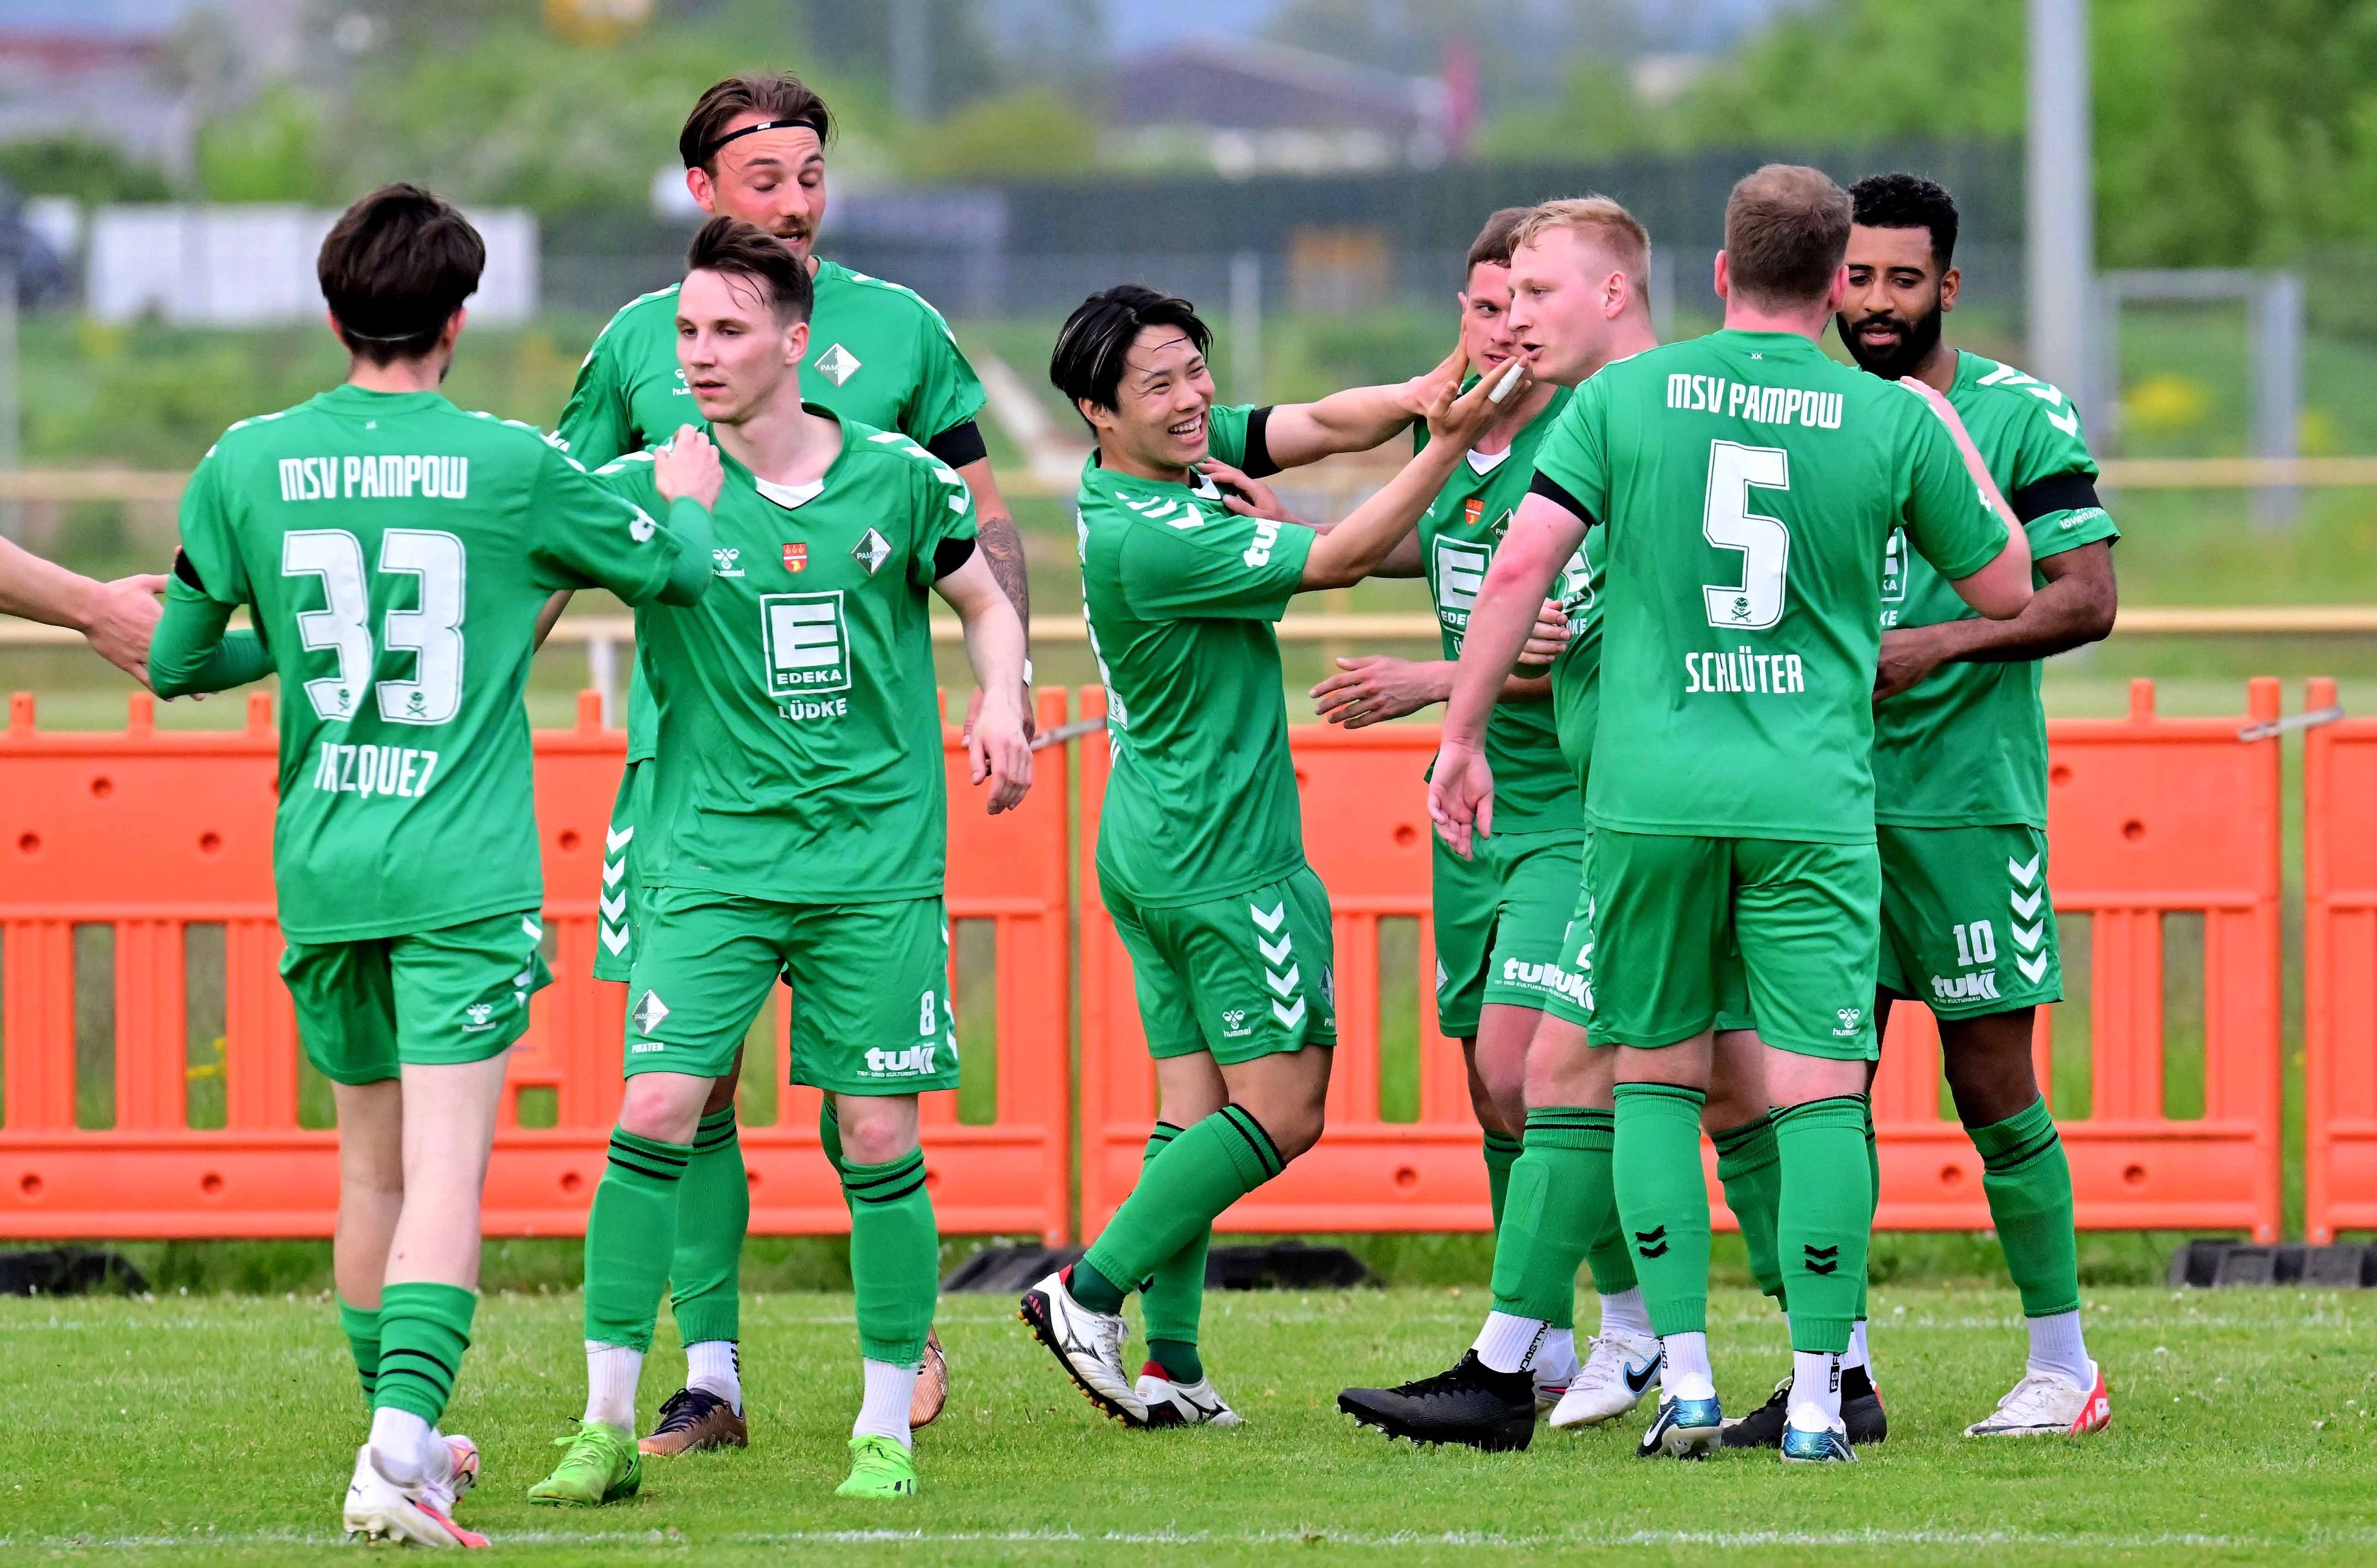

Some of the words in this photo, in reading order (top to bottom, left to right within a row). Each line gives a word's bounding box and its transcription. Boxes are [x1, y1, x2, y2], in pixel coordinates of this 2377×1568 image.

[672, 387, 692, 396] hum
[1667, 374, 1725, 414] MSV
[1729, 383, 1843, 429] PAMPOW
[279, 458, 338, 501] MSV
[344, 455, 468, 500] PAMPOW
[1703, 439, 1790, 630] 5
[281, 528, 467, 726] 33
[770, 602, 840, 669] E
[1441, 610, 1471, 626] EDE
[777, 669, 842, 684] EDEKA
[1685, 646, 1805, 694] SCHLÜTER
[778, 698, 847, 720] LÜDKE
[1953, 920, 1996, 966] 10
[920, 990, 935, 1036] 8
[1224, 1027, 1251, 1037] hummel
